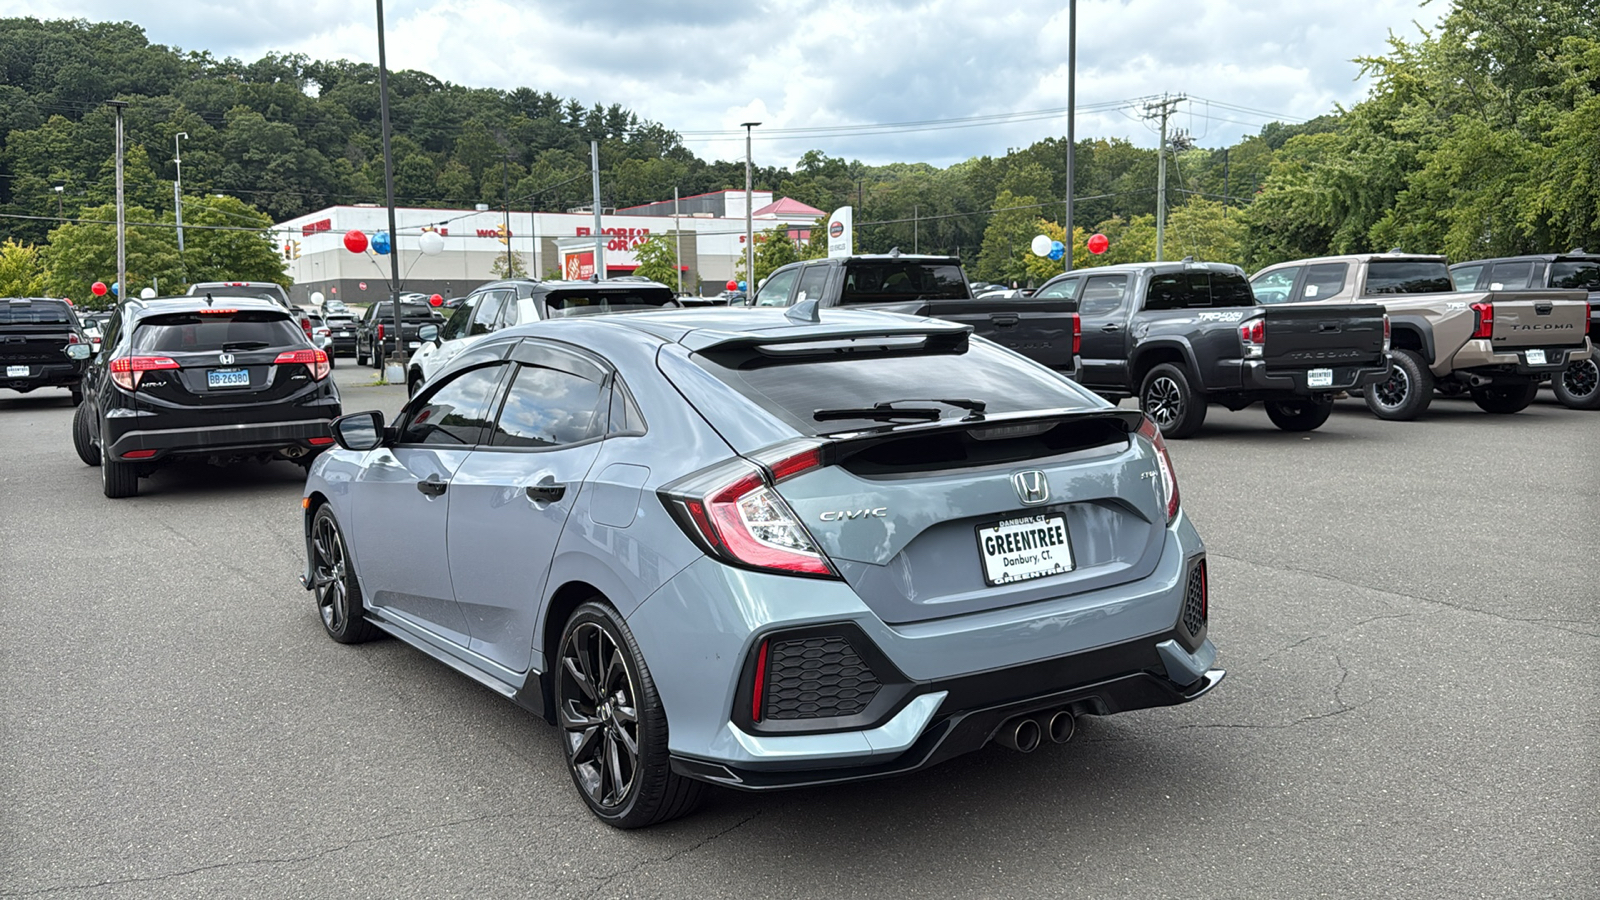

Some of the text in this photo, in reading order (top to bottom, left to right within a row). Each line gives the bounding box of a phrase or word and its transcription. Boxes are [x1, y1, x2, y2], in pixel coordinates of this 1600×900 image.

[1511, 323, 1574, 331] TACOMA
[1291, 350, 1360, 360] TACOMA
[210, 373, 248, 385] BB-26380
[820, 507, 887, 522] CIVIC
[1036, 514, 1046, 523] CT
[985, 525, 1064, 556] GREENTREE
[1003, 550, 1053, 567] Danbury, CT.
[994, 565, 1073, 585] GREENTREE
